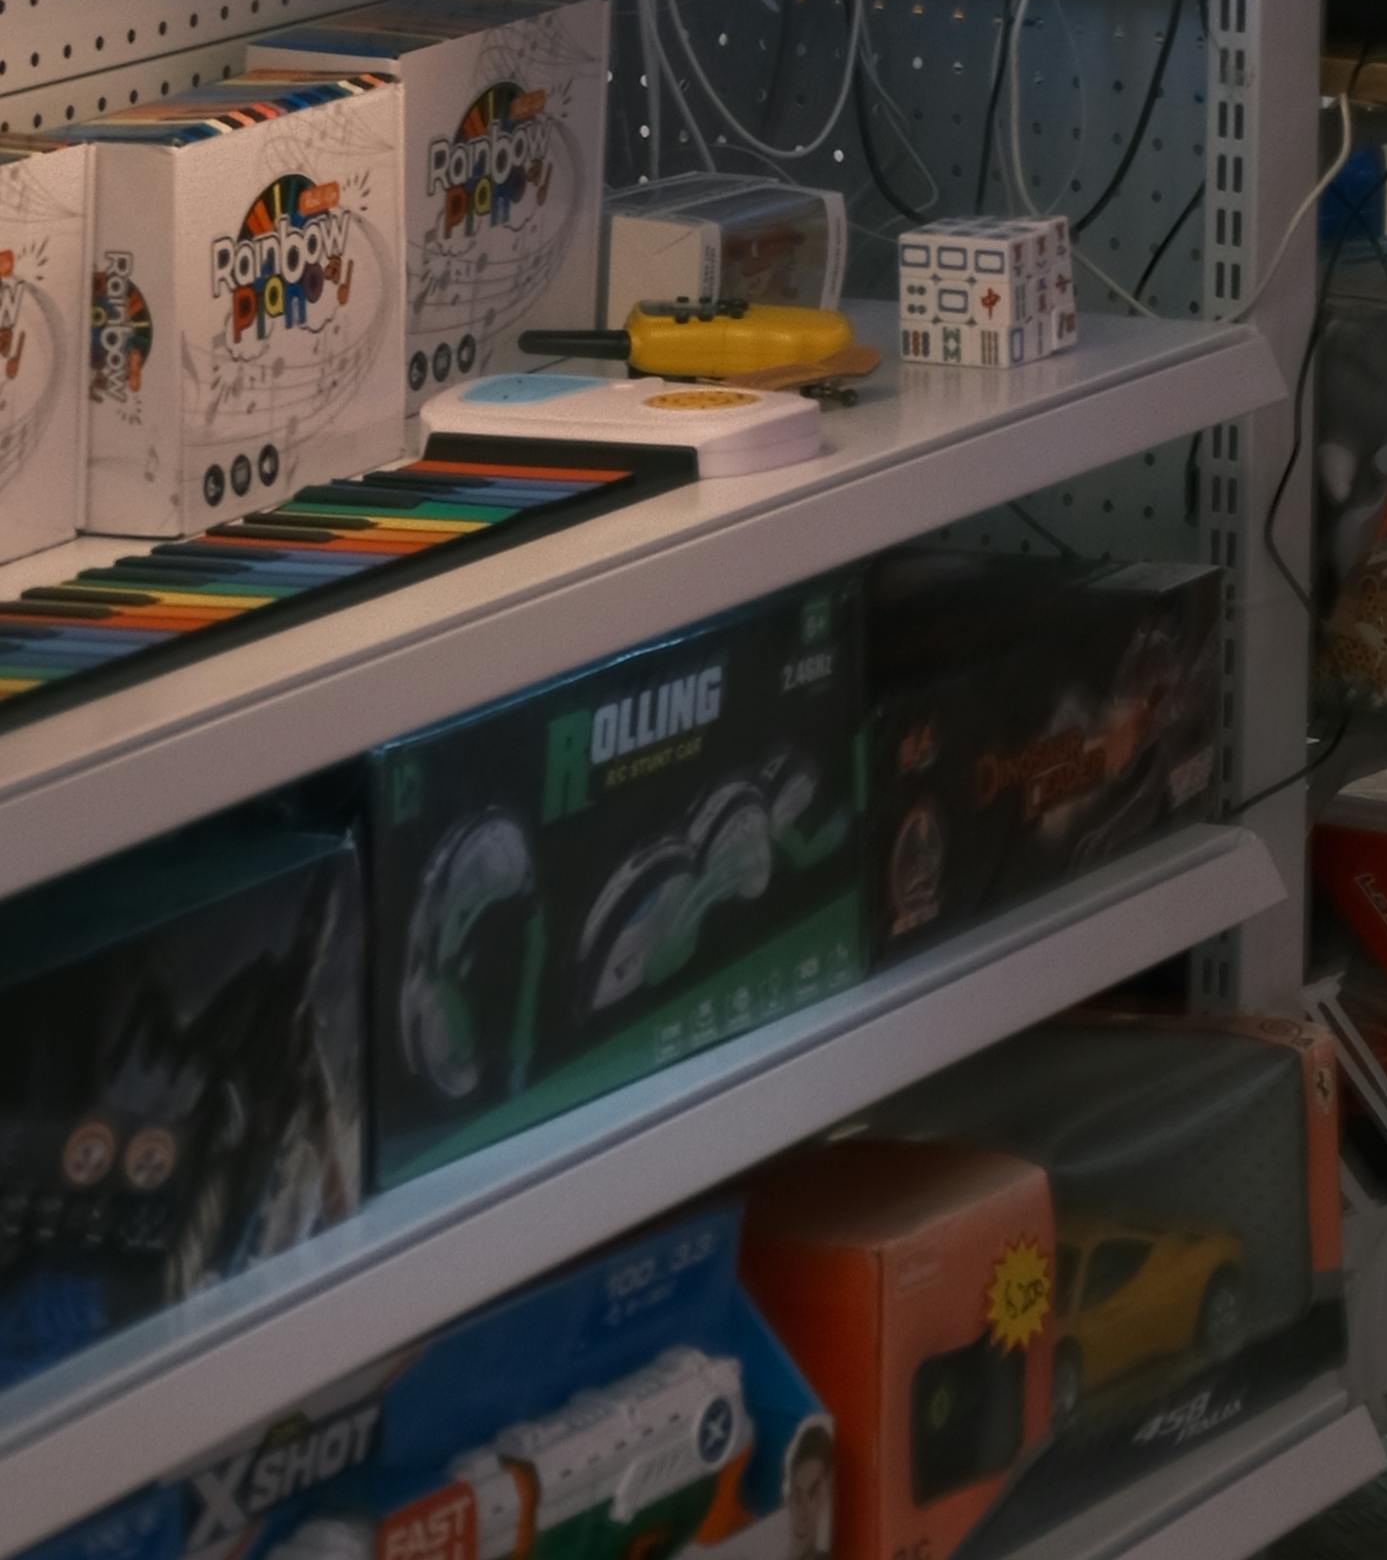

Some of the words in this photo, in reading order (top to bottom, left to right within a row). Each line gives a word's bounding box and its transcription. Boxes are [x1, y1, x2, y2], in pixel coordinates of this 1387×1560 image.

[427, 121, 553, 196] Rainbow
[211, 208, 352, 300] Rainbow
[103, 250, 134, 403] Rainbow
[541, 662, 724, 826] ROLLING
[971, 726, 1086, 810] DINOSAUR
[384, 1497, 473, 1556] FAST
